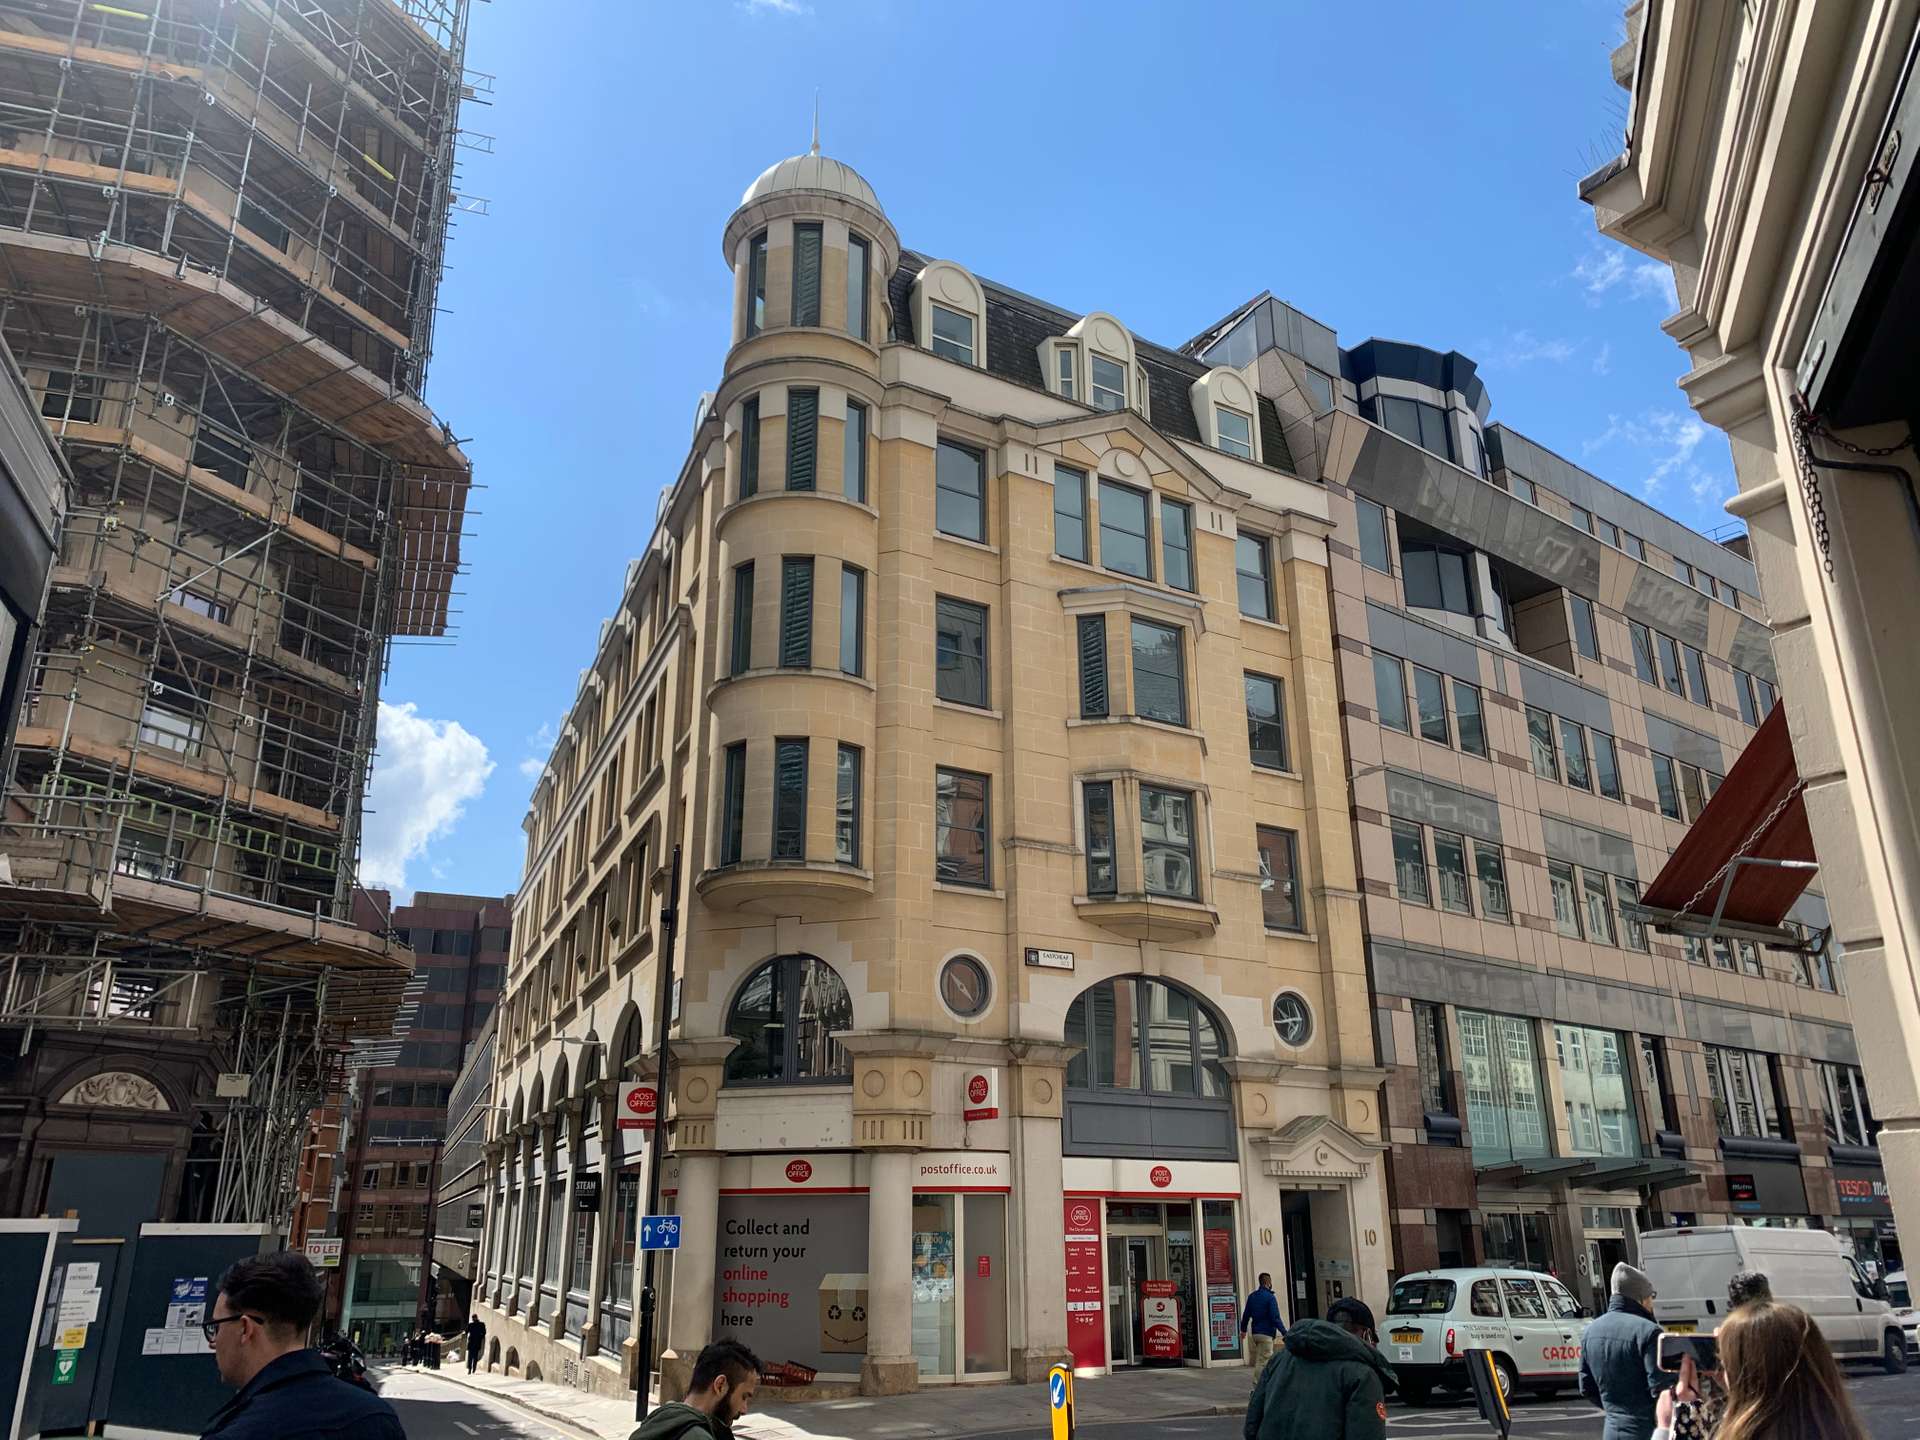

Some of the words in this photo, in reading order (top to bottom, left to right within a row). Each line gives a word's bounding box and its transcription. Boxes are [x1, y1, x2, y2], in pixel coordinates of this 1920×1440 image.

[970, 1087, 986, 1097] OFFICE
[972, 1080, 984, 1089] POST
[634, 1092, 654, 1100] POST
[629, 1100, 657, 1108] OFFICE
[787, 1170, 809, 1178] OFFICE
[920, 1163, 998, 1176] postoffice.co.uk
[575, 1181, 596, 1190] STEAM
[1152, 1175, 1170, 1183] OFFICE
[1837, 1180, 1873, 1197] TESCO
[725, 1218, 779, 1236] Collect
[782, 1218, 810, 1236] and
[1259, 1227, 1272, 1246] 10
[1364, 1229, 1377, 1247] 10
[308, 1245, 320, 1254] TO
[323, 1245, 340, 1254] LET
[723, 1246, 768, 1258] return
[772, 1246, 806, 1263] your
[722, 1264, 768, 1281] online
[1579, 1254, 1588, 1276] 8
[722, 1286, 790, 1309] shopping
[720, 1309, 754, 1327] here
